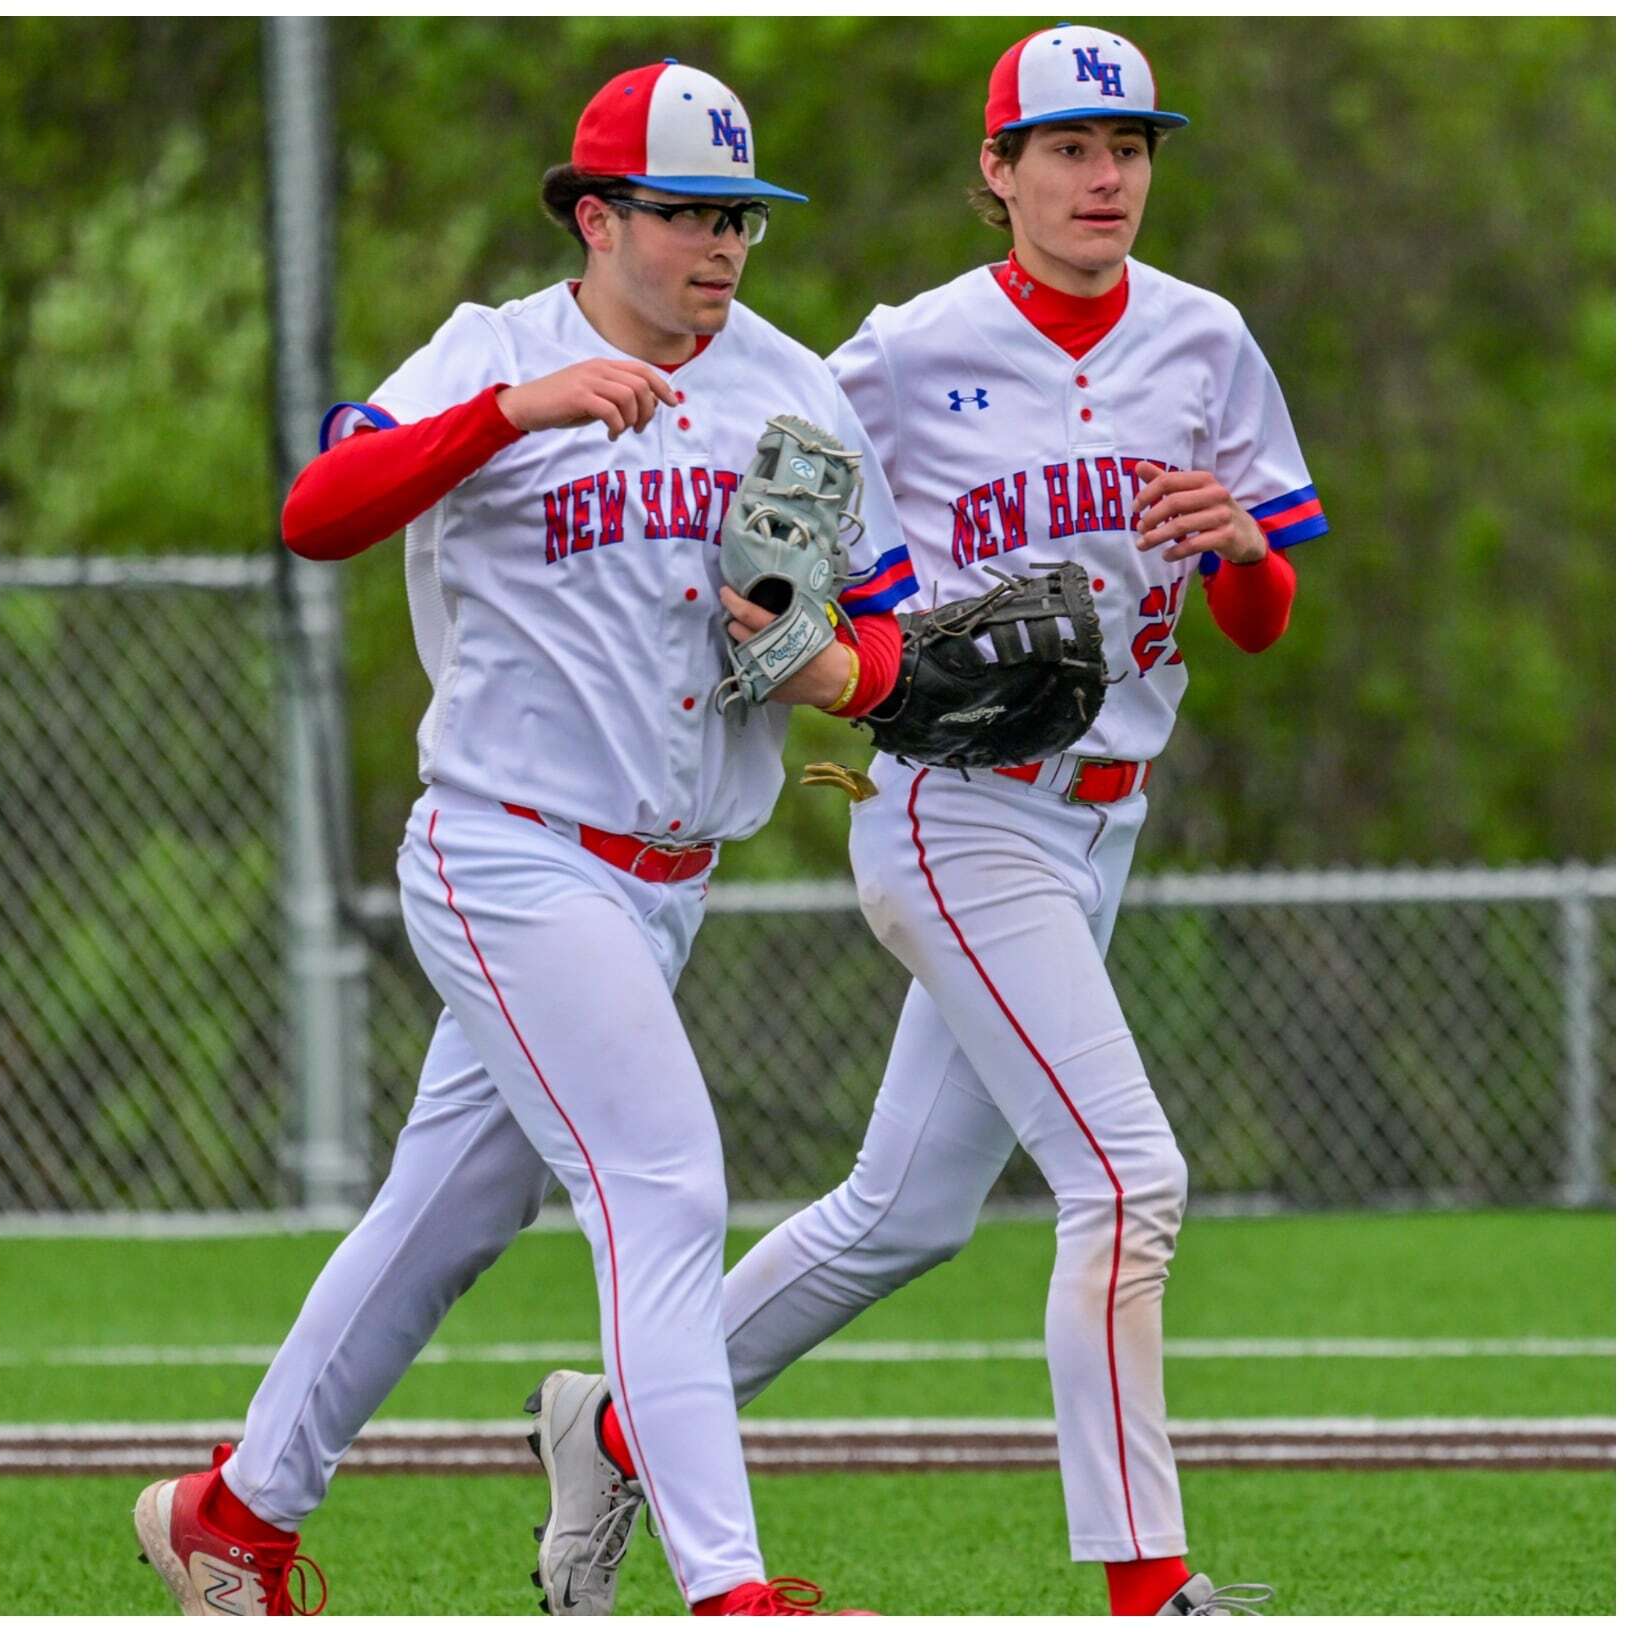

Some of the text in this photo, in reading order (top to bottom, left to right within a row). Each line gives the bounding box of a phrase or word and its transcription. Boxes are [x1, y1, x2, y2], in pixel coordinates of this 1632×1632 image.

[1071, 46, 1126, 98] NH
[707, 108, 749, 164] NH
[543, 467, 744, 565] NEW HART
[947, 456, 1186, 570] NEW HART
